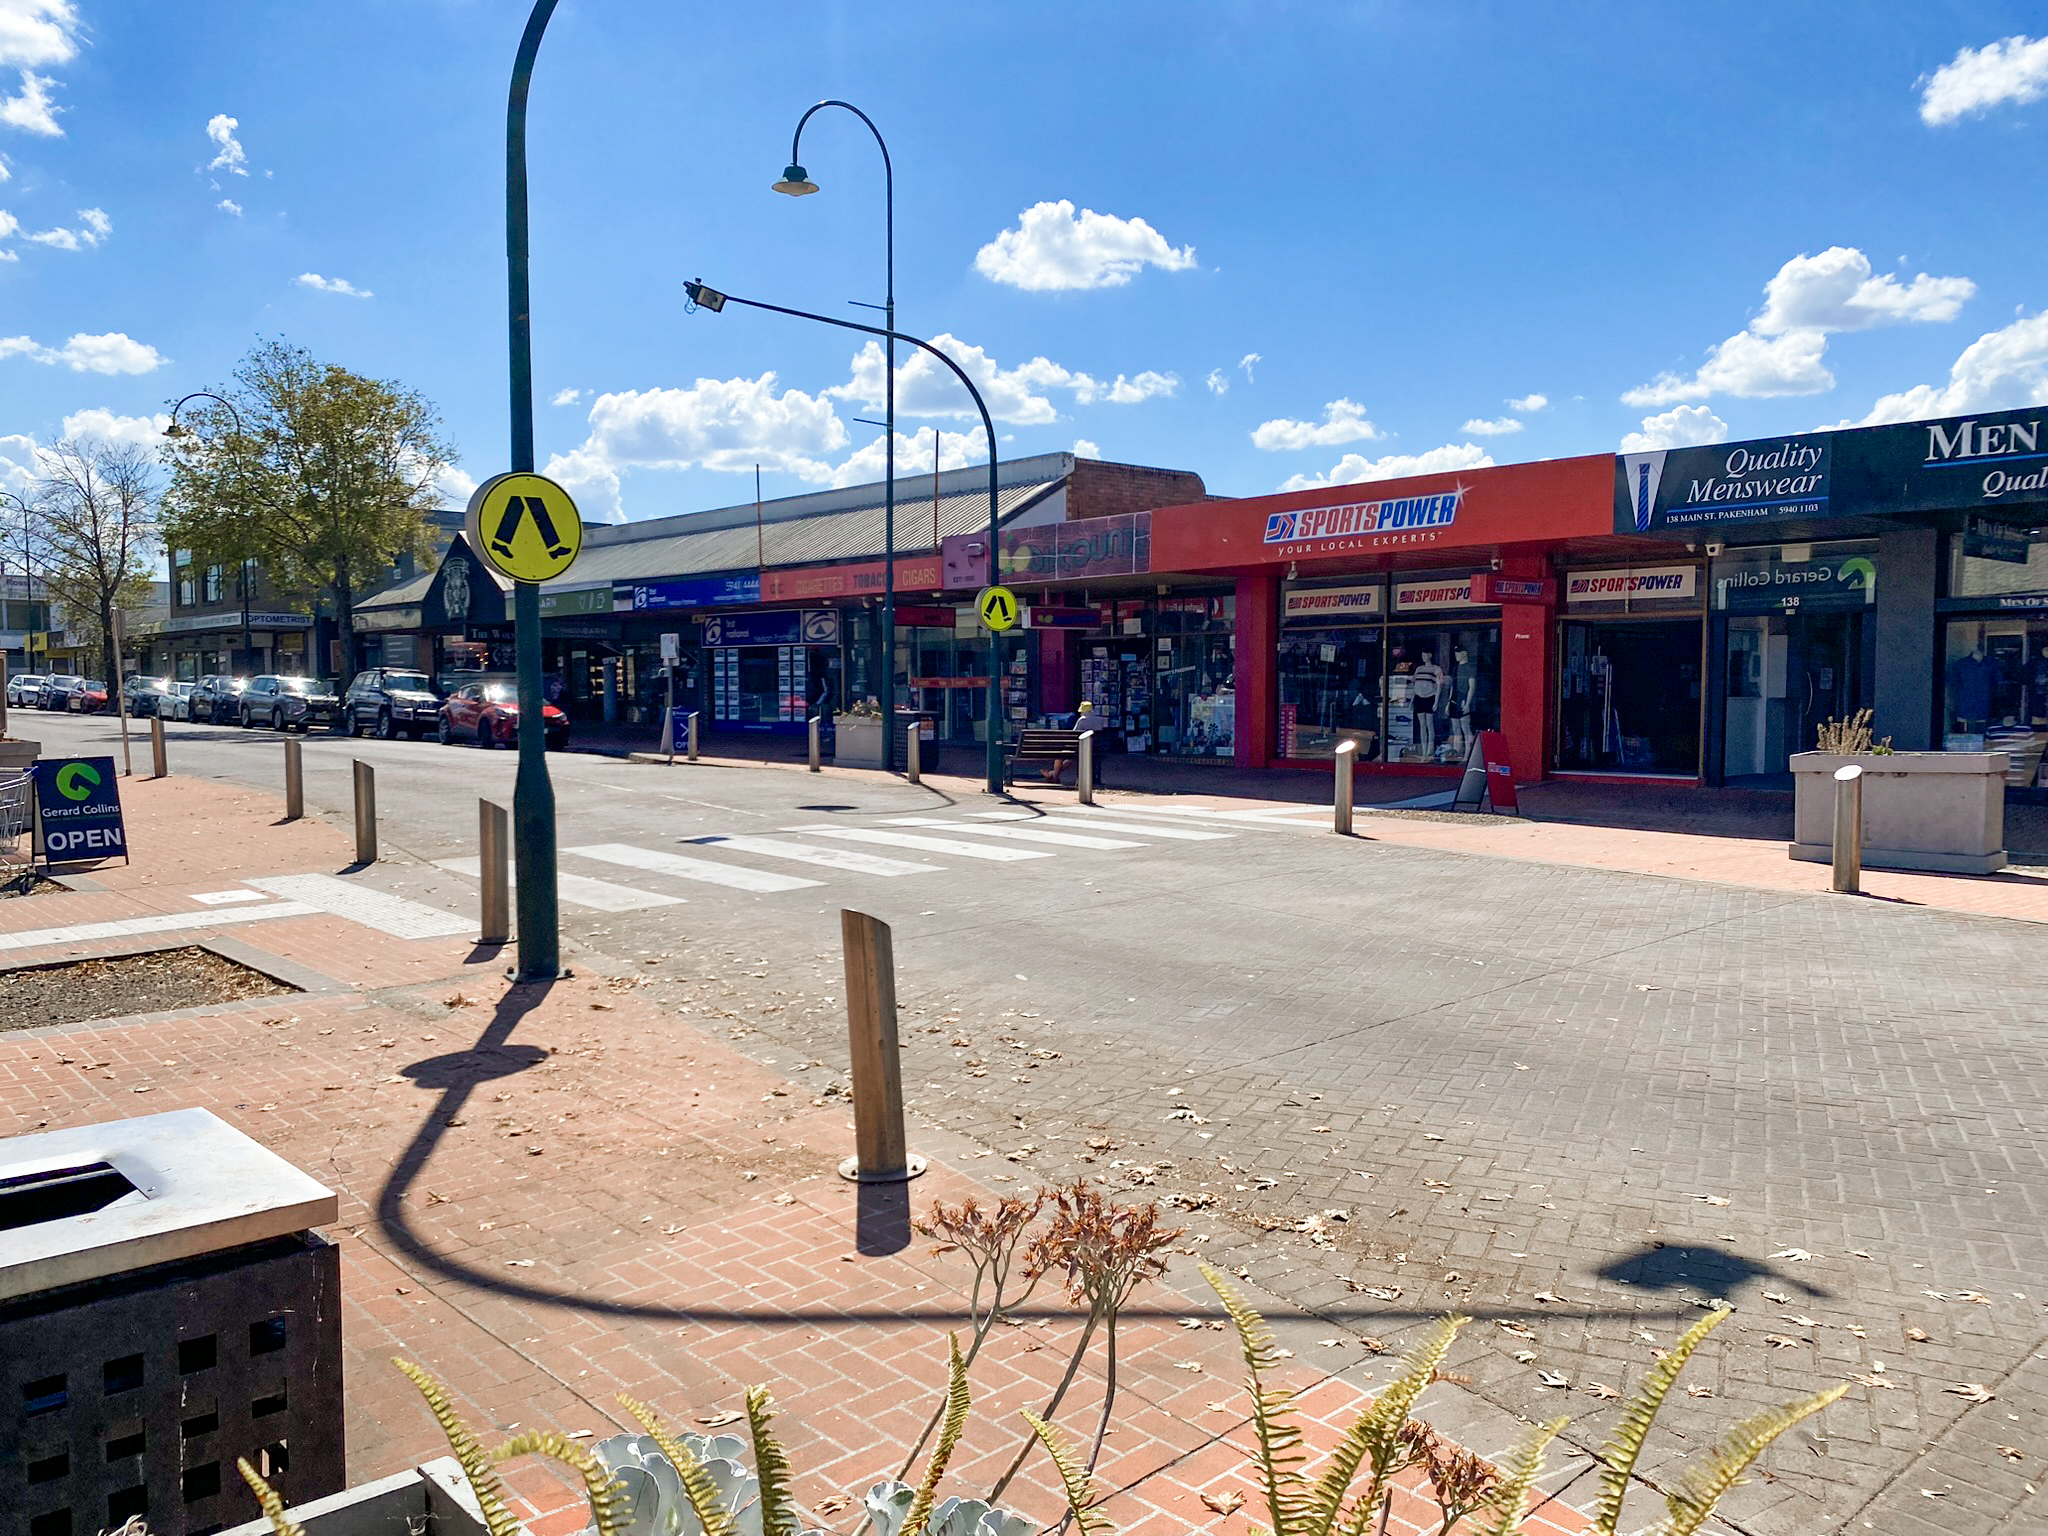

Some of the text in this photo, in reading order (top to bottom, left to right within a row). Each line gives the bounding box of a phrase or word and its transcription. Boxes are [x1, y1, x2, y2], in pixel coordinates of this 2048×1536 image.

[1924, 420, 2041, 461] MEN
[1725, 442, 1823, 479] Quality
[1686, 474, 1823, 503] Menswear
[1982, 466, 2048, 498] Qual
[1299, 495, 1457, 537] SPORTSPOWER
[1666, 503, 1819, 524] 138 MAIN ST. PAKENHAM 5940 1103
[1278, 544, 1312, 557] YOUR
[1321, 539, 1364, 551] LOCAL
[853, 572, 894, 589] TOBACC
[902, 567, 936, 586] CIGARS
[1589, 574, 1683, 592] SPORTSPOWER
[1301, 593, 1371, 609] SPORTSPOWER
[1781, 597, 1800, 607] 138
[247, 614, 311, 624] OPTOMETRIST
[42, 804, 120, 817] Gerard Collins
[47, 828, 122, 851] OPEN
